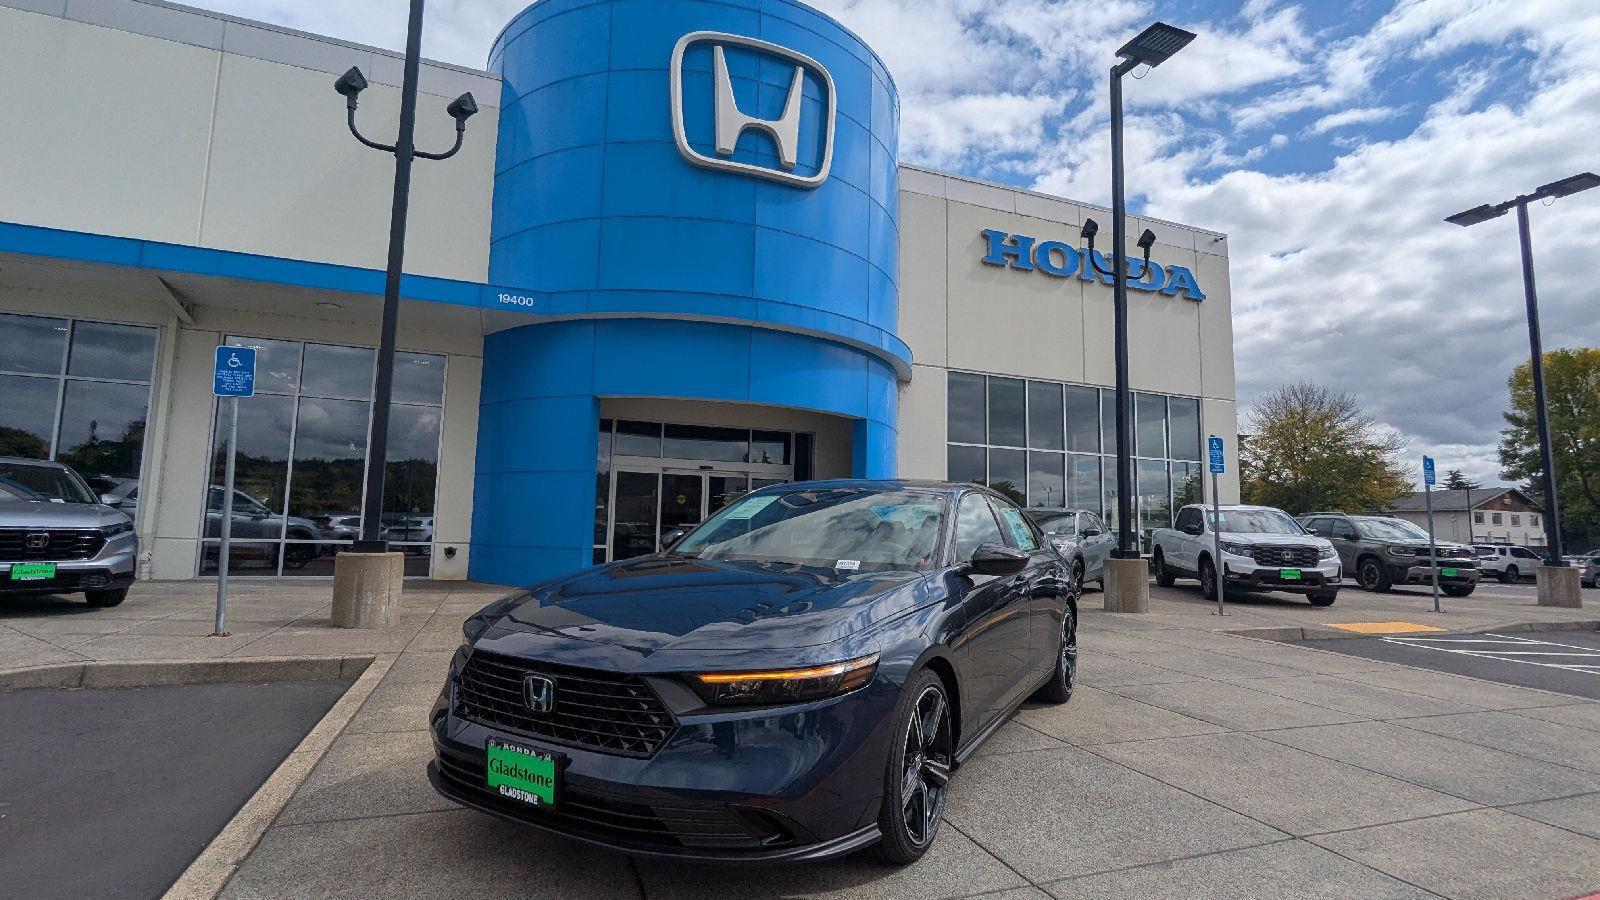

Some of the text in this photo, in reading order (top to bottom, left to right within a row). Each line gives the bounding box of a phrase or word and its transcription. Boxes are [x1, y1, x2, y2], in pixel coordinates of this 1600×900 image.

[982, 228, 1206, 302] HONDA
[498, 293, 534, 307] 19400
[503, 743, 537, 757] HONDA
[489, 757, 553, 788] Gladstone
[500, 785, 538, 805] GLADSTONE
